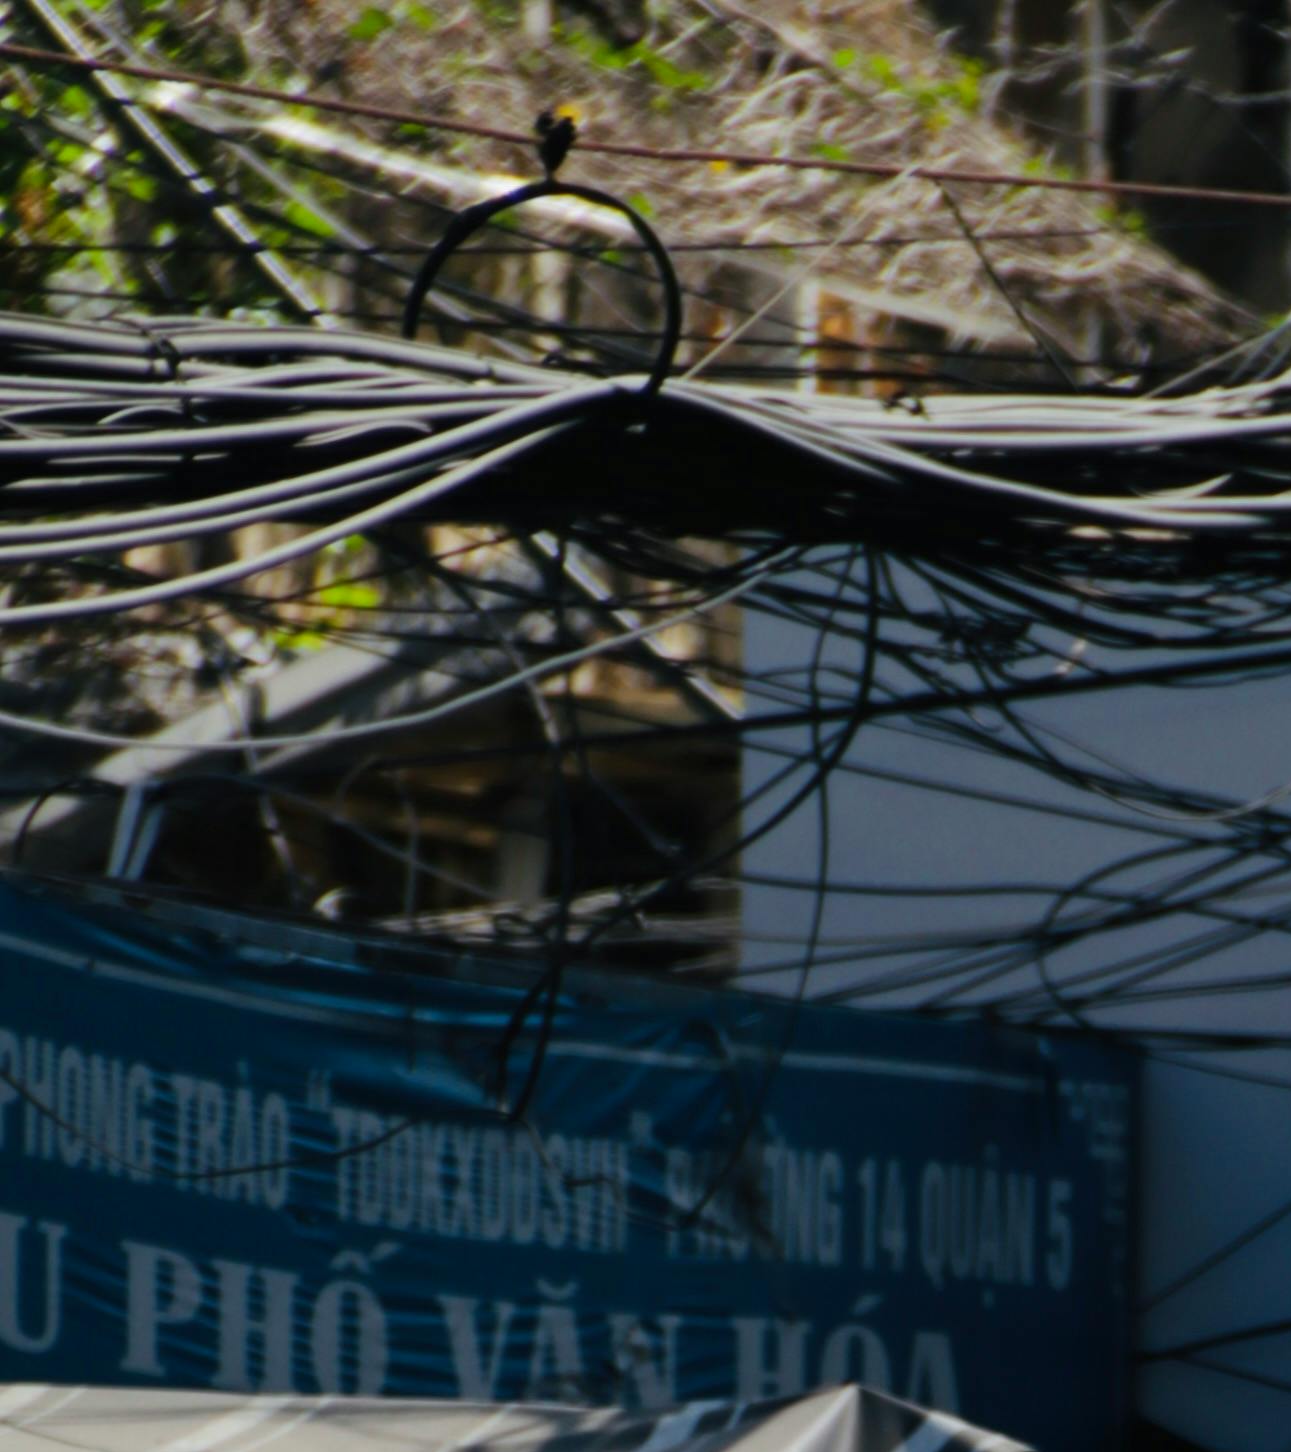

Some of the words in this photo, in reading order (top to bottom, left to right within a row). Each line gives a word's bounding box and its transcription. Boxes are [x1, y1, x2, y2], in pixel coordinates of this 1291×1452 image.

[858, 1155, 906, 1272] 14
[1046, 1177, 1073, 1292] 5
[119, 1240, 403, 1397] PHỐ
[436, 1276, 681, 1404] VĂN
